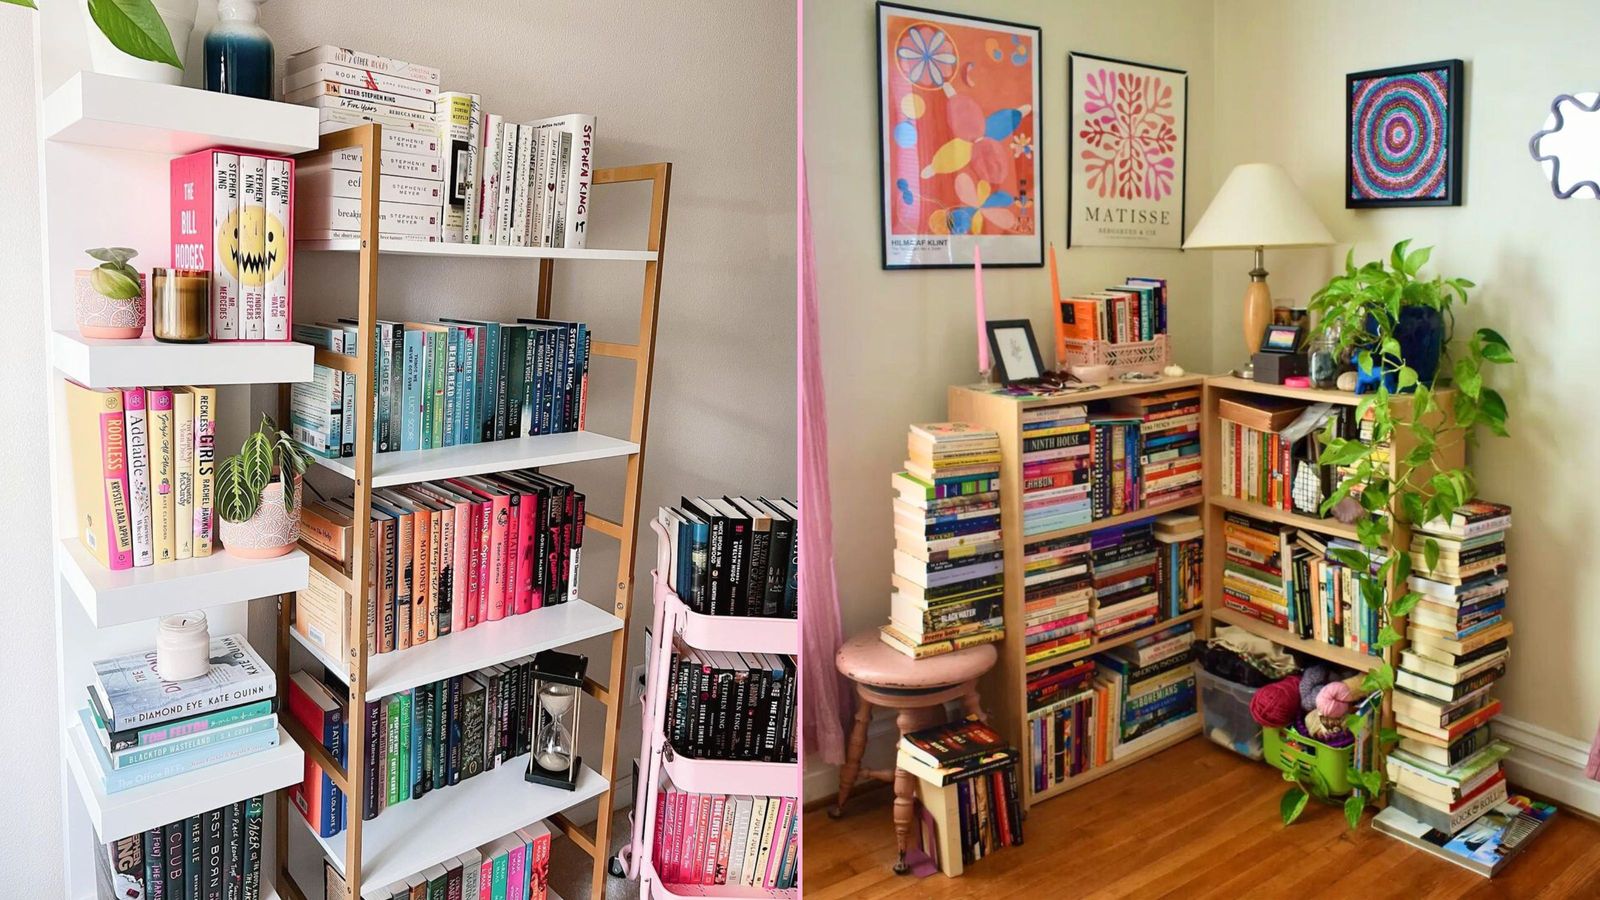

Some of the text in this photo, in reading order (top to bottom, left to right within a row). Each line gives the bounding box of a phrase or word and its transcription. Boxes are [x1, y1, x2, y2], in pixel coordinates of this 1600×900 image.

[336, 71, 356, 79] ROOM
[344, 88, 383, 101] LATER STEPHEN
[360, 103, 378, 112] Years
[389, 136, 424, 144] STEPHENIE
[341, 153, 358, 161] new
[391, 159, 425, 167] STEPHENIE
[528, 140, 536, 187] CONFESS
[577, 125, 592, 215] STEPHEN KING
[184, 183, 194, 200] THE
[218, 170, 227, 190] KING
[246, 174, 254, 194] KING
[256, 168, 264, 203] STEPHEN
[271, 177, 279, 196] KING
[280, 170, 288, 205] STEPHEN
[393, 184, 427, 192] STEPHENIE
[181, 210, 197, 235] BILL
[1086, 207, 1170, 225] MATISSE
[175, 243, 204, 270] HODGES
[219, 286, 228, 320] MERCEDES
[246, 293, 254, 320] KEEPERS
[270, 296, 279, 318] WATCH
[279, 310, 286, 318] OF
[448, 346, 456, 373] BEACH
[566, 328, 576, 390] STEPHEN KING
[333, 388, 342, 404] After
[199, 395, 214, 475] RECKLESS GIRLS
[1154, 421, 1170, 430] FRENCH
[130, 415, 146, 477] Adelaide
[1032, 435, 1079, 450] NINTH HOUSE
[107, 419, 129, 548] ROOTLESS KRYSTLE ZARA APPIAH
[178, 472, 186, 506] McCurdy
[201, 479, 210, 539] RACHEL HAWKINS
[386, 525, 394, 555] RUTH
[480, 507, 491, 568] Honey Spice
[509, 534, 517, 559] MAID
[752, 534, 762, 567] SCHWAB
[385, 558, 393, 589] WARE
[470, 570, 476, 578] of
[469, 582, 478, 592] Pi
[385, 603, 393, 612] IT
[221, 638, 259, 676] KATE QUINN
[690, 669, 699, 709] Keeping Lucy
[721, 681, 729, 710] STEPHEN
[736, 681, 745, 711] STEPHEN
[1139, 684, 1178, 706] BOHEMIANS
[124, 686, 264, 724] THE DIAMOND EYE KATE QUINN
[371, 708, 378, 719] My
[698, 704, 706, 723] SIERRA
[142, 720, 209, 743] TOM FELTON
[674, 702, 682, 740] HAUNTED
[129, 735, 211, 764] BLACKTOP WASTELAND
[765, 727, 776, 749] KILLER
[117, 768, 163, 788] The Office
[1451, 808, 1471, 828] ROCK
[1480, 792, 1498, 810] ROLL
[192, 823, 200, 843] HER
[232, 818, 240, 838] PLACE
[248, 818, 261, 850] SAGER
[706, 800, 723, 874] BOOK LOVERS EMILY HENRY
[750, 818, 761, 856] JULIE JULIA
[152, 837, 162, 878] FOLEY THE
[170, 832, 182, 880] CLUB
[230, 840, 238, 862] WRONG
